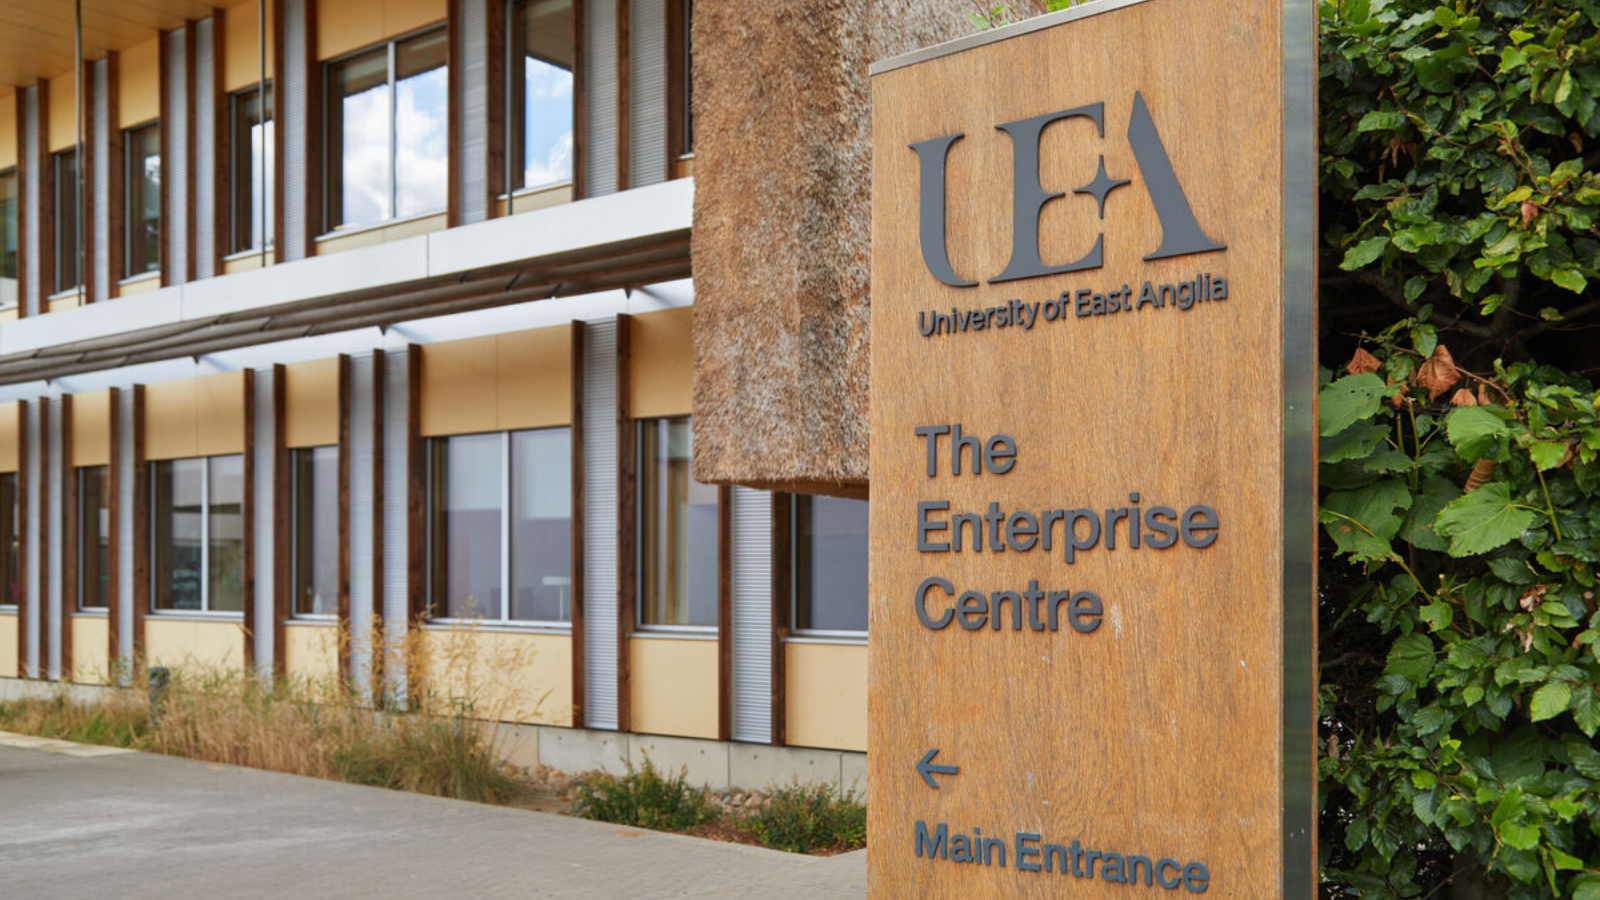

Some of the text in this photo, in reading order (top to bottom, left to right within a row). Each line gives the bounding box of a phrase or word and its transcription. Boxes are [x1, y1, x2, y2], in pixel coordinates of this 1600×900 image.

[907, 90, 1228, 288] UEA
[917, 273, 1228, 337] University of East Anglia
[914, 423, 1017, 477] The
[916, 492, 1220, 564] Enterprise
[914, 576, 1104, 633] Centre
[914, 820, 1210, 893] Main Entrance
